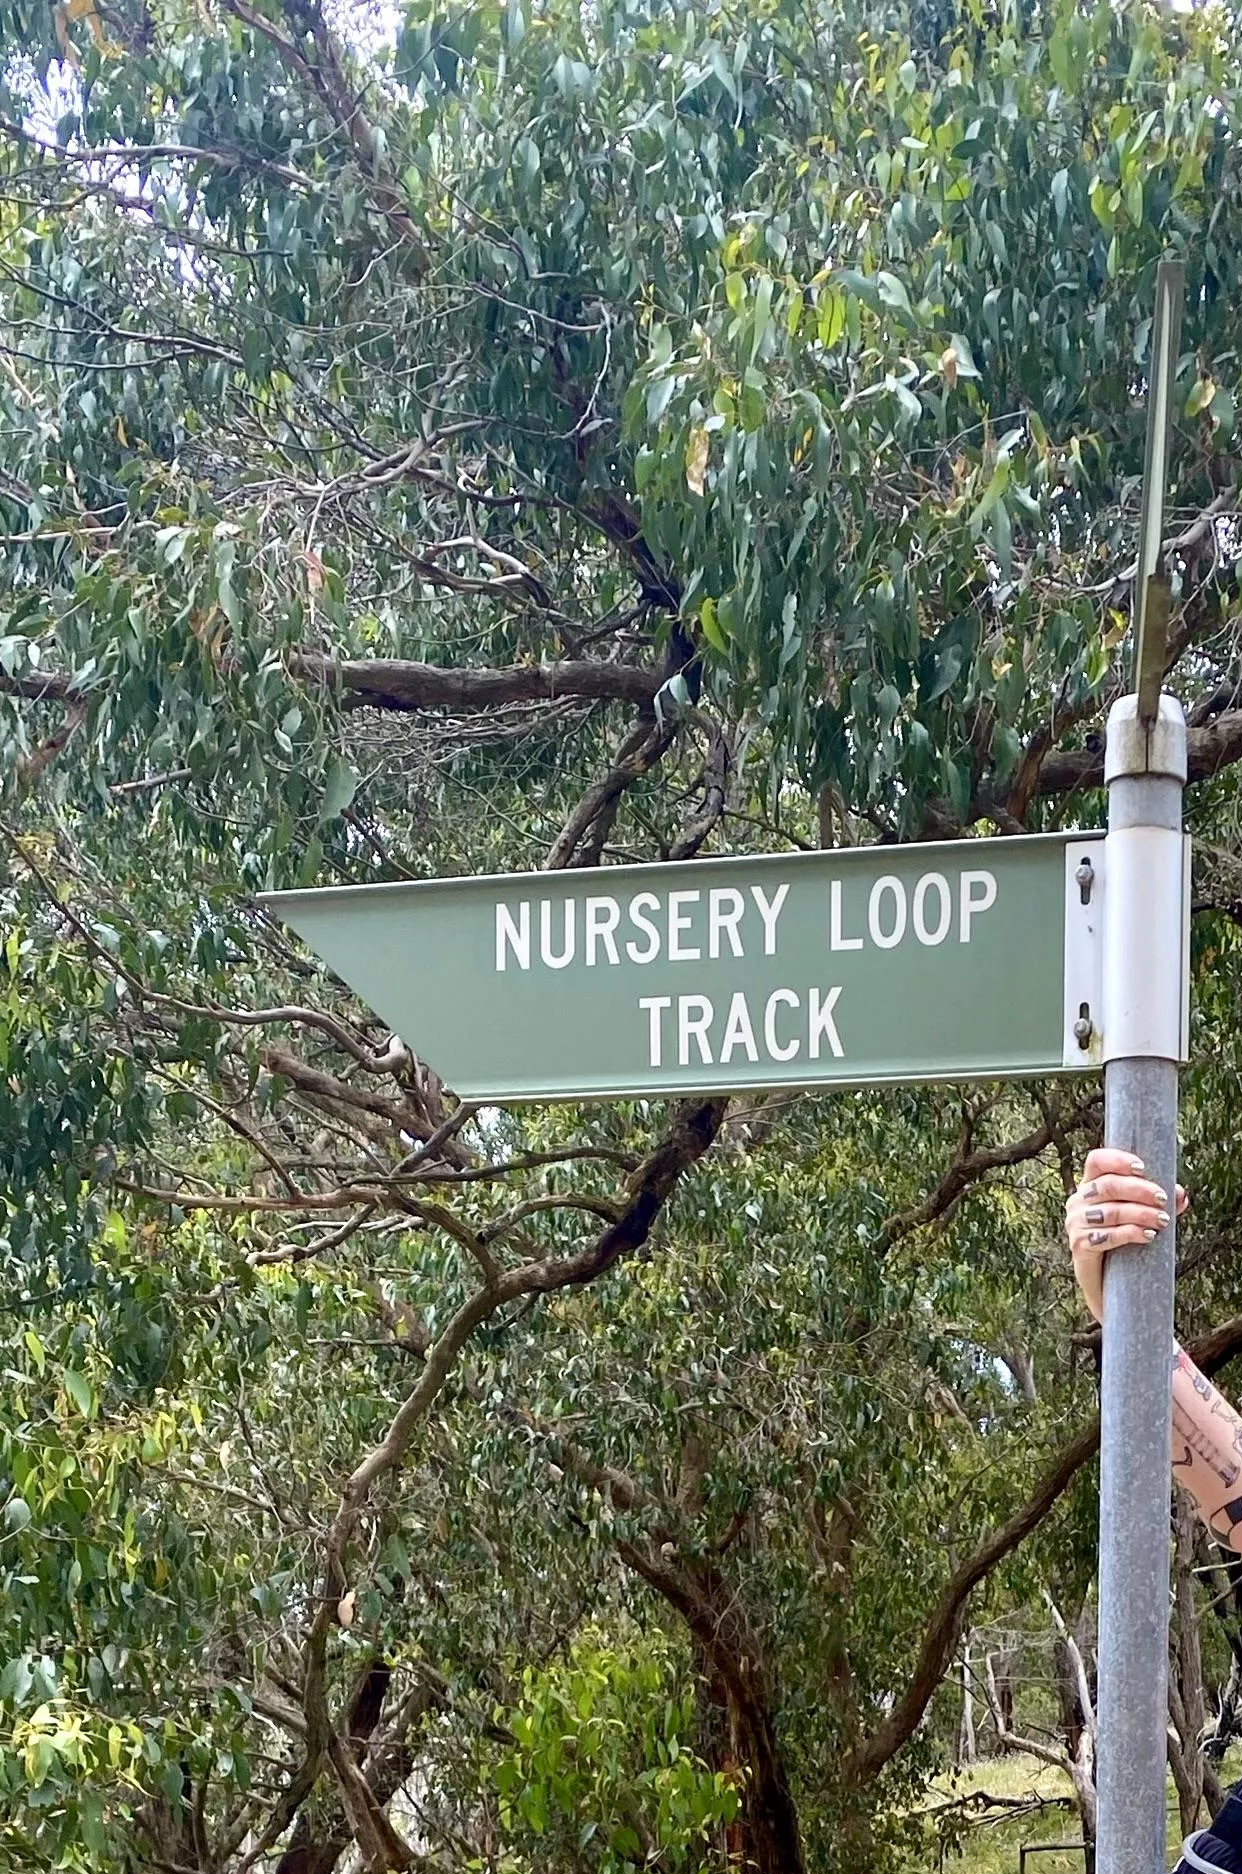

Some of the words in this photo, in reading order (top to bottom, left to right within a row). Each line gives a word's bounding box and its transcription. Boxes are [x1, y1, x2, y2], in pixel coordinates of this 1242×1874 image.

[496, 883, 790, 972] NURSERY
[831, 870, 998, 951] LOOP
[639, 986, 846, 1067] TRACK
